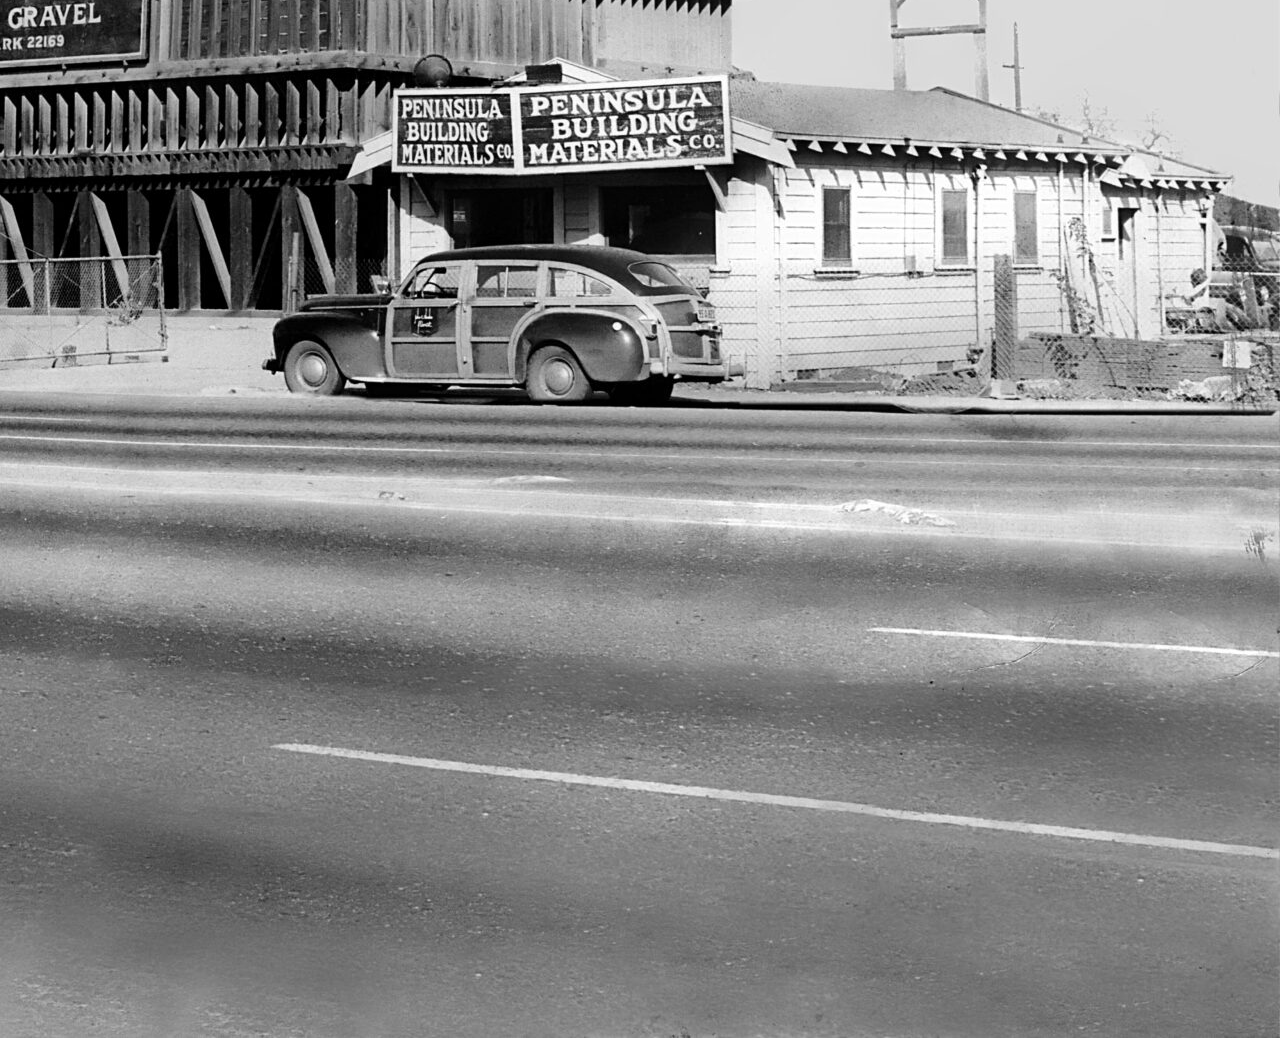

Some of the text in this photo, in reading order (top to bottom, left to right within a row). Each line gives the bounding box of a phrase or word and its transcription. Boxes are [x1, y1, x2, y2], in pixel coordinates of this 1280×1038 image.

[8, 2, 101, 30] GRAVEL
[27, 34, 65, 49] 22169
[401, 98, 504, 119] PENINSULA
[530, 87, 713, 117] PENINSULA
[407, 122, 489, 142] BUILDING
[551, 110, 698, 139] BUILDING
[401, 144, 514, 165] MATERIALS CO.
[528, 134, 720, 164] MATERIALS CO.
